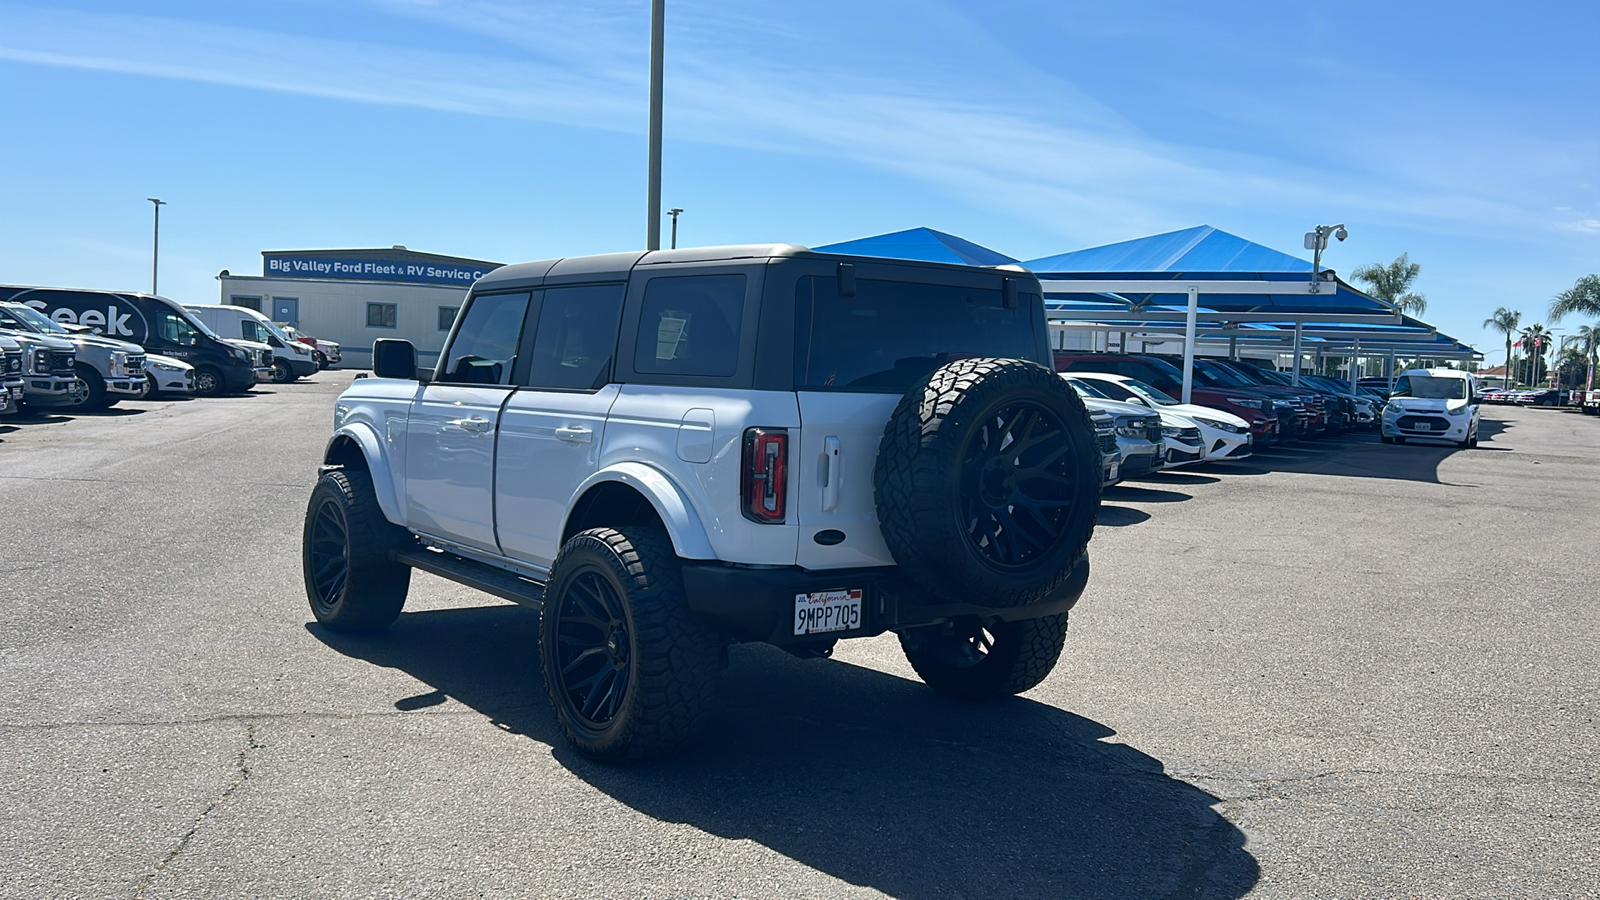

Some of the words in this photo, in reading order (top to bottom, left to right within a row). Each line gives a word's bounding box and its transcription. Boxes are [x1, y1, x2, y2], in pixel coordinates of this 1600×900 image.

[270, 260, 291, 272] Big
[293, 261, 331, 274] Valley
[334, 262, 362, 273] Ford
[364, 263, 396, 274] Fleet
[397, 267, 405, 275] &
[407, 265, 424, 276] RV
[426, 267, 471, 280] Service
[473, 270, 486, 281] C
[808, 593, 851, 606] California
[798, 604, 858, 630] 9MPP705
